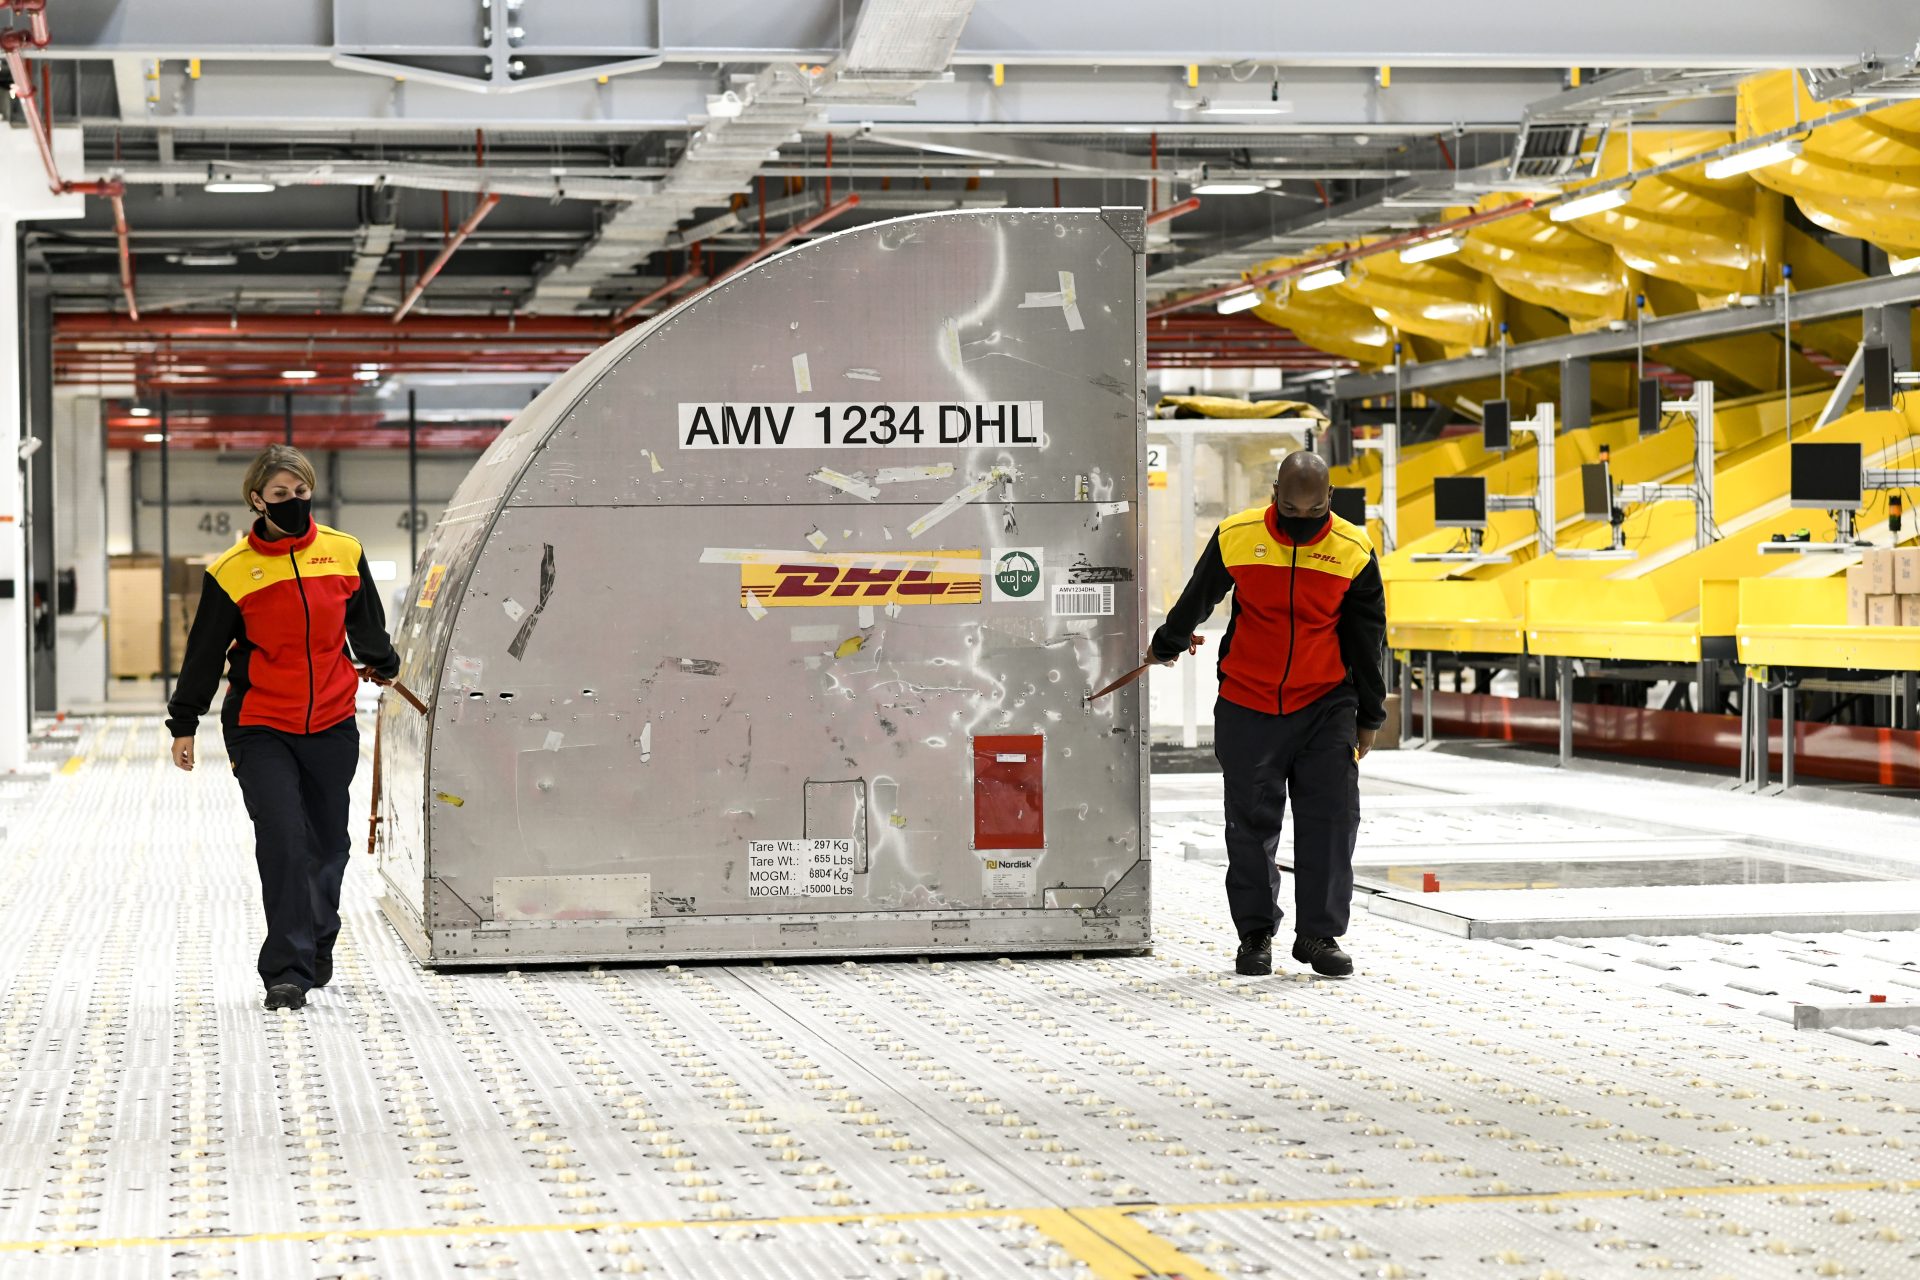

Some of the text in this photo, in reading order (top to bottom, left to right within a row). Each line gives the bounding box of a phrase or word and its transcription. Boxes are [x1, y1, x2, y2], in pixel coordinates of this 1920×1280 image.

[686, 404, 1038, 445] AMV 1234 DHL
[198, 511, 231, 535] 48
[397, 509, 429, 533] 49
[308, 556, 337, 565] DHL
[1310, 552, 1339, 564] DHL
[771, 560, 950, 598] DHL
[1000, 575, 1033, 583] ULD OK
[750, 841, 774, 852] Tare
[814, 840, 831, 850] 297
[833, 840, 849, 853] Kg
[750, 856, 774, 867] Tare
[814, 854, 831, 863] 655
[833, 855, 854, 866] Lbs
[998, 860, 1032, 869] Nordisk
[809, 868, 831, 879] 6804
[833, 870, 849, 883] Kg
[833, 885, 853, 895] Lbs
